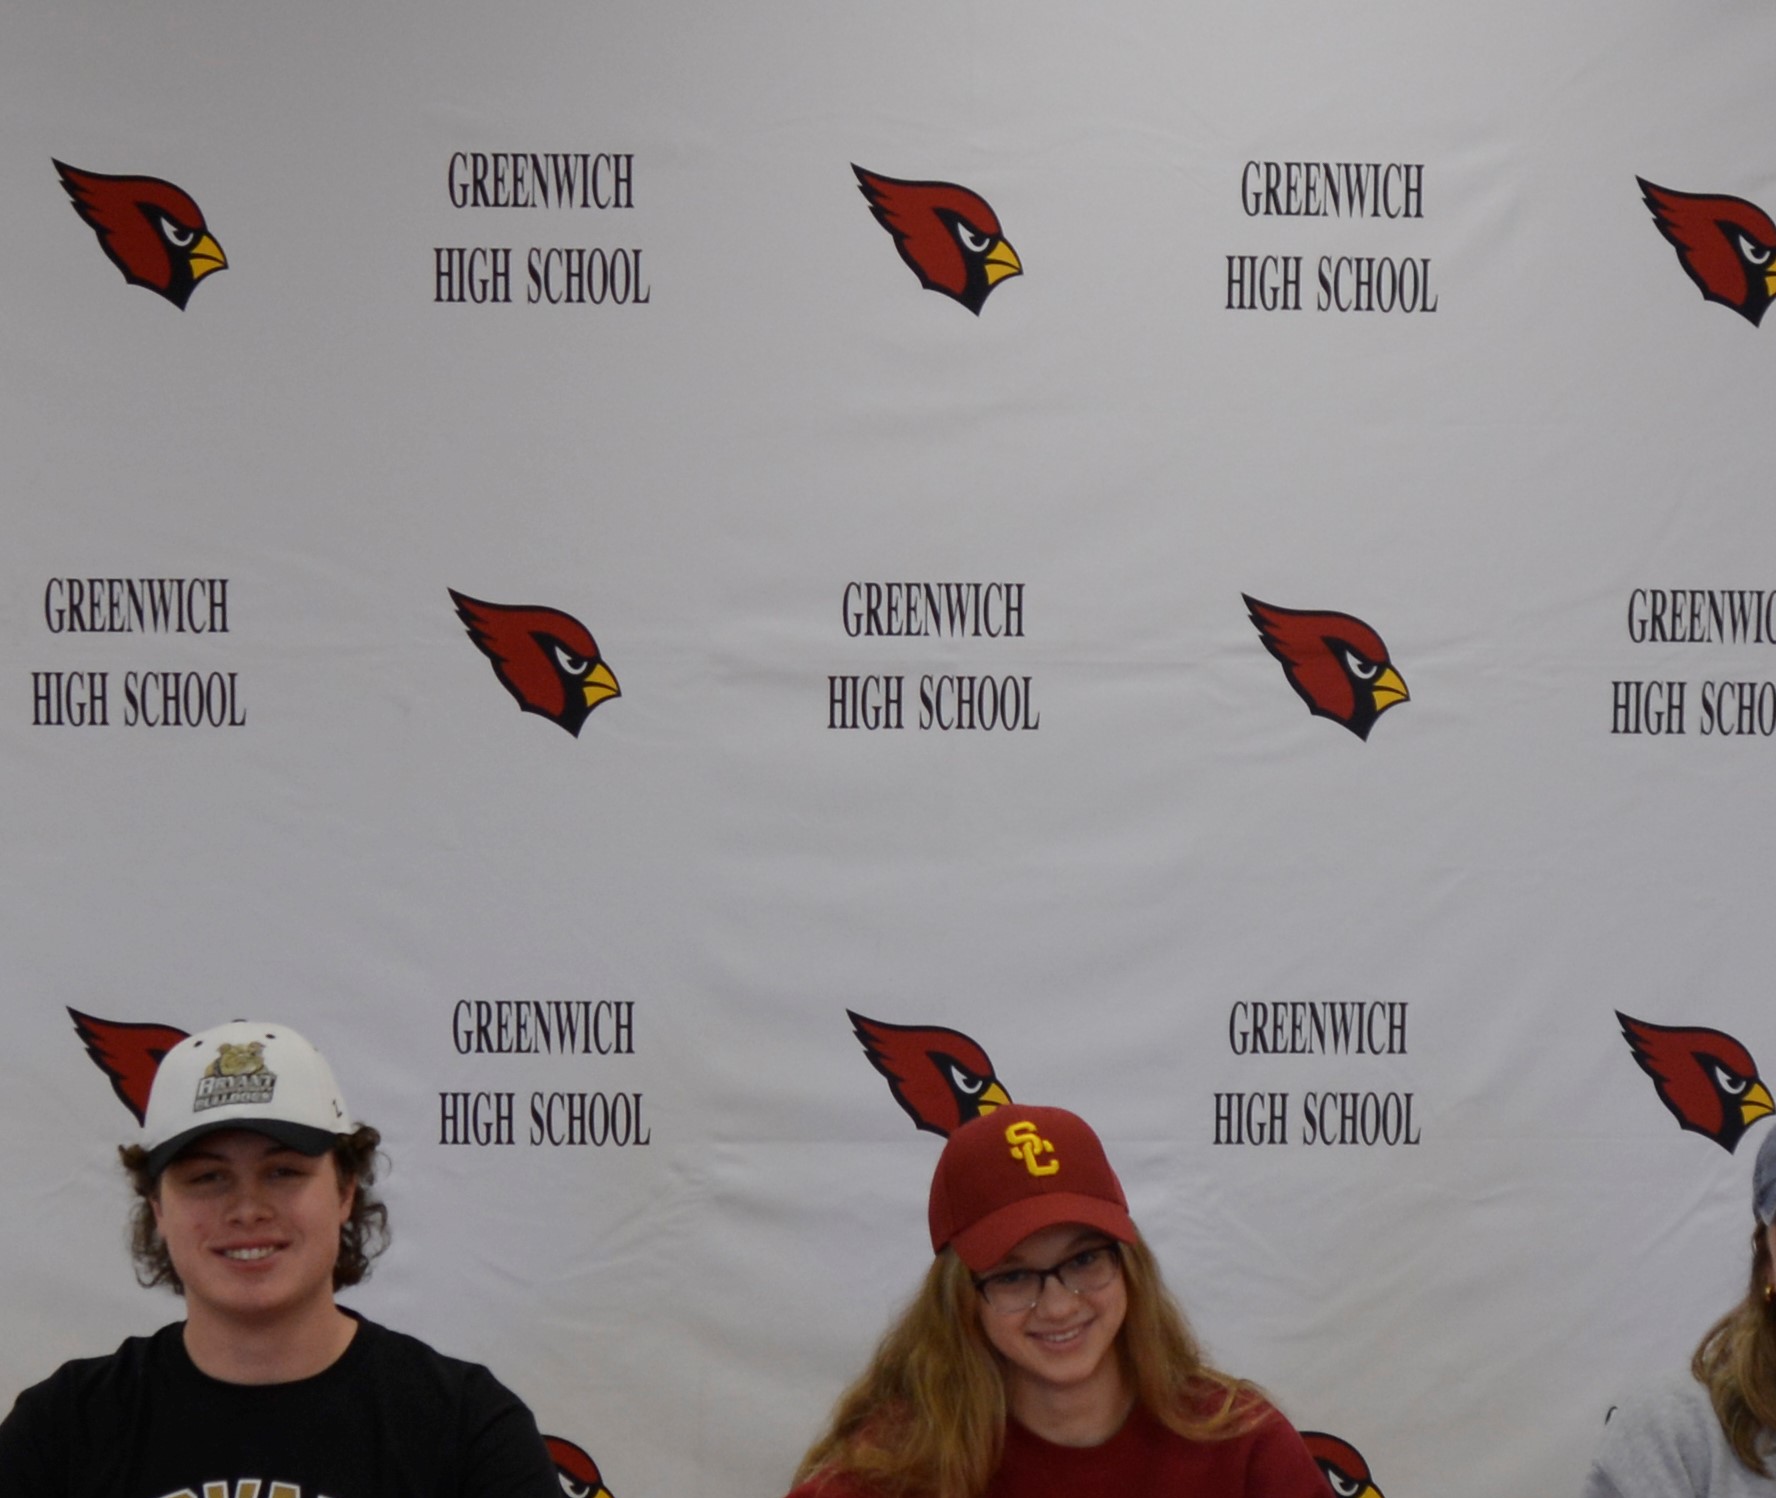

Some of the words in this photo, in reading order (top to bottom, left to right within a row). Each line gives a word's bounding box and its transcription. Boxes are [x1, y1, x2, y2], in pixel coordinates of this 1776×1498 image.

[448, 152, 633, 209] GREENWICH
[1242, 161, 1424, 219] GREENWICH
[434, 248, 512, 303] HIGH
[528, 248, 649, 304] SCHOOL
[1226, 256, 1302, 311] HIGH
[1318, 256, 1437, 313] SCHOOL
[45, 578, 229, 633] GREENWICH
[843, 582, 1025, 637] GREENWICH
[32, 672, 109, 726] HIGH
[125, 671, 246, 727] SCHOOL
[828, 675, 904, 730] HIGH
[920, 675, 1039, 731] SCHOOL
[1611, 681, 1686, 735] HIGH
[453, 1000, 634, 1055] GREENWICH
[1230, 1001, 1408, 1055] GREENWICH
[439, 1092, 515, 1146] HIGH
[531, 1092, 650, 1146] SCHOOL
[1214, 1093, 1288, 1145] HIGH
[1303, 1092, 1420, 1146] SCHOOL
